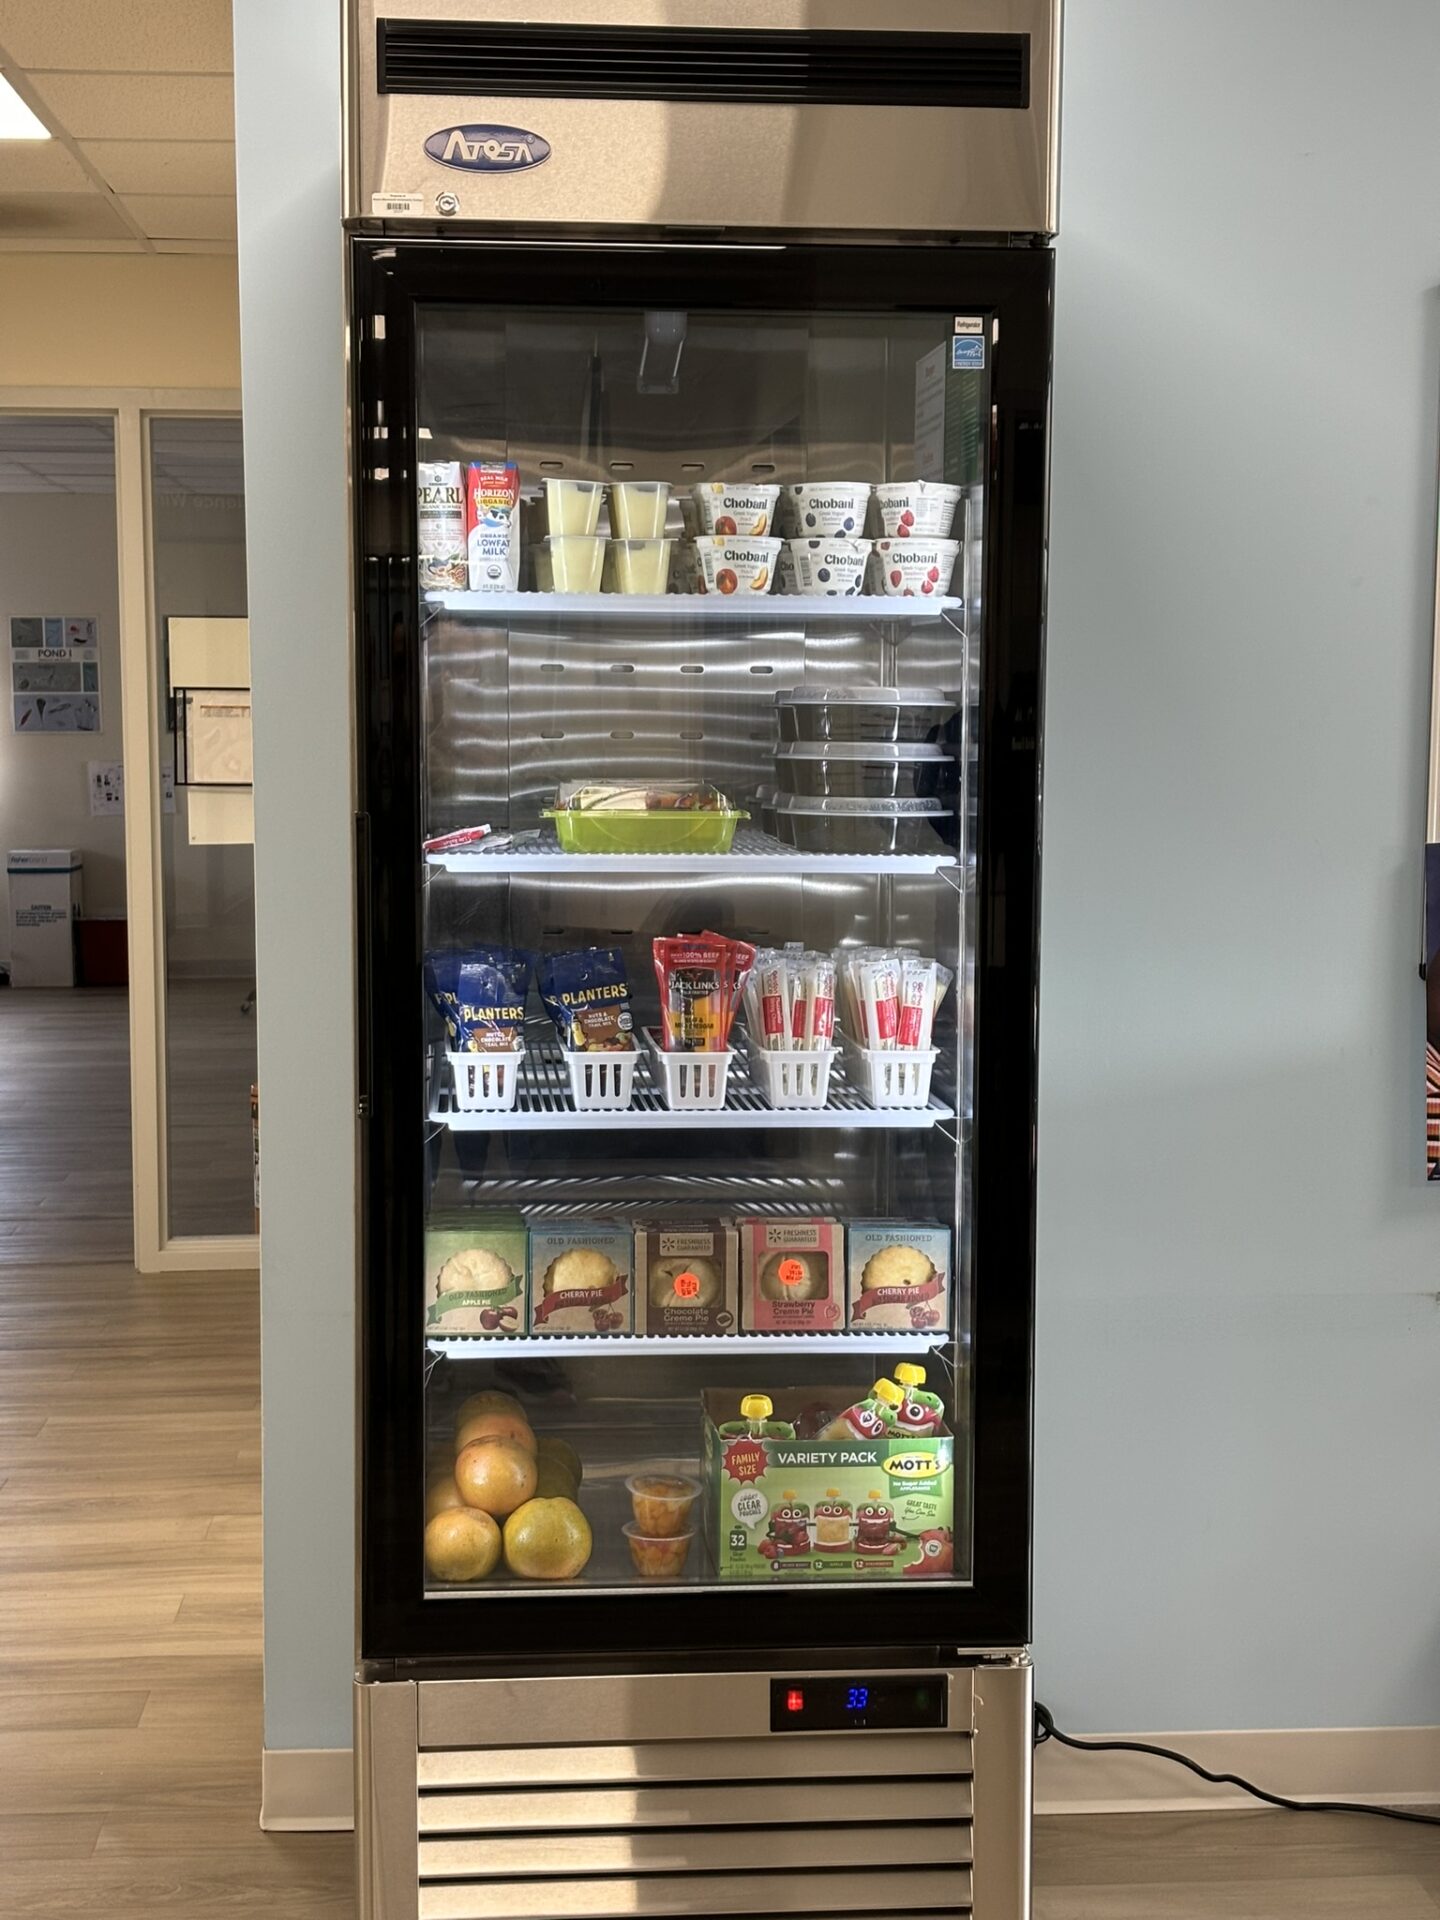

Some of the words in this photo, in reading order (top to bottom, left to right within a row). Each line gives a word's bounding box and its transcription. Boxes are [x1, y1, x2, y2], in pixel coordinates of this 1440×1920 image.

[474, 488, 514, 500] HORIZON
[723, 497, 768, 510] Chobani
[809, 498, 854, 510] Chobani
[477, 539, 511, 547] LOWFAT
[482, 547, 507, 556] MILK
[724, 550, 769, 563] Chobani
[824, 554, 865, 567] Chobani
[892, 553, 938, 564] Chobani
[37, 649, 66, 657] POND
[671, 981, 692, 990] JACK
[562, 983, 628, 1006] PLANTERS
[464, 1006, 524, 1023] PLANTERS
[547, 1237, 564, 1245] OLD
[567, 1236, 615, 1244] FASHIONED
[885, 1234, 932, 1242] FASHIONED
[560, 1290, 590, 1299] CHERRY
[591, 1289, 603, 1297] PIE
[877, 1288, 906, 1296] CHERRY
[908, 1286, 920, 1295] PIE
[732, 1451, 760, 1466] FAMILY
[778, 1452, 838, 1464] VARIETY
[840, 1451, 877, 1463] PACK
[738, 1464, 757, 1476] SIZE
[889, 1460, 941, 1471] MOTTS
[737, 1499, 761, 1511] CLEAR
[730, 1534, 745, 1547] 32
[815, 1561, 823, 1569] 12
[846, 1687, 869, 1708] 33
